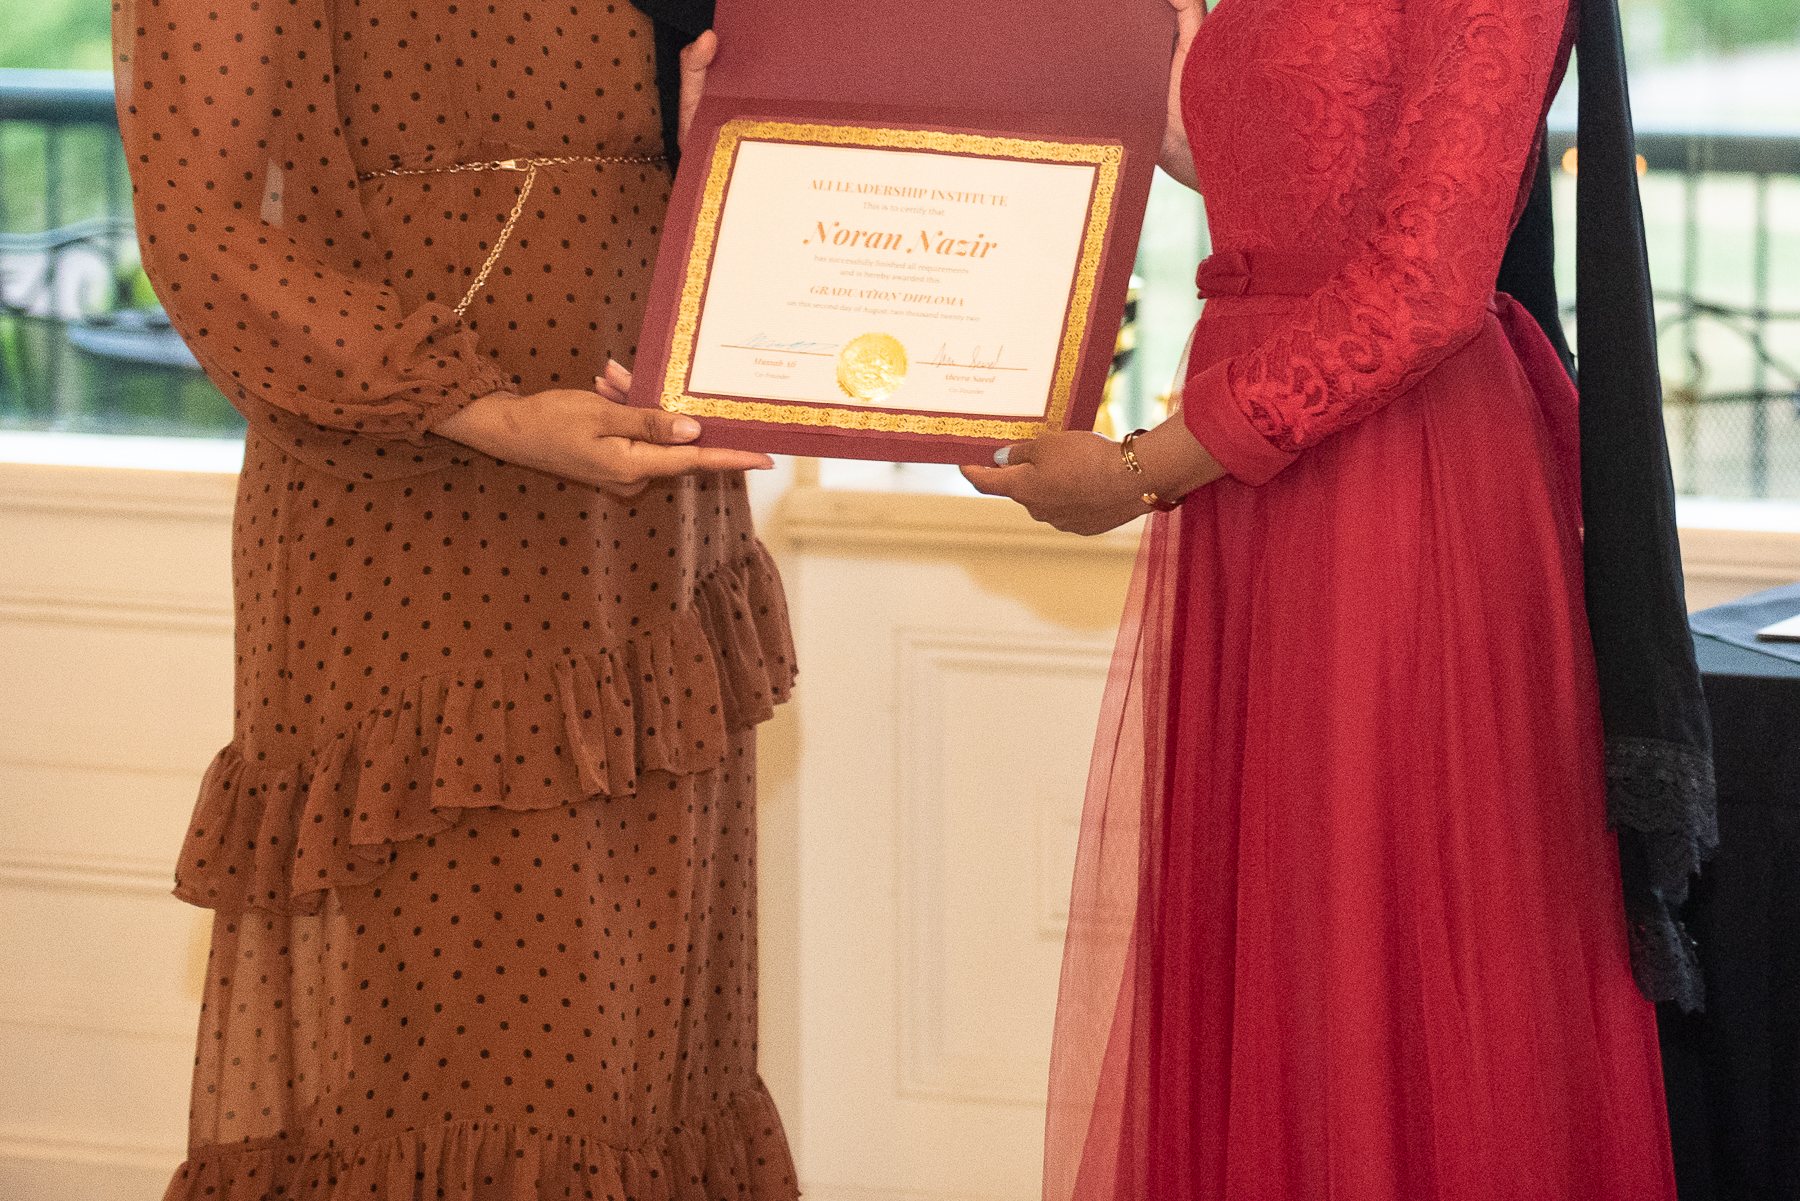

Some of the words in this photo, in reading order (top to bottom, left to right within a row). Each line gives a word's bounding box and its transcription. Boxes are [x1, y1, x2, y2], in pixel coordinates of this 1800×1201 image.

[808, 179, 832, 191] ALI
[835, 181, 927, 199] LEADERSHIP
[930, 189, 1009, 207] INSTITUTE
[863, 201, 880, 210] This
[881, 203, 888, 211] is
[890, 204, 899, 212] to
[900, 206, 926, 216] certify
[928, 208, 945, 216] that
[802, 220, 903, 251] Noran
[906, 229, 998, 259] Nazir
[809, 285, 902, 302] GRADUATION
[902, 293, 964, 307] DIPLOMA
